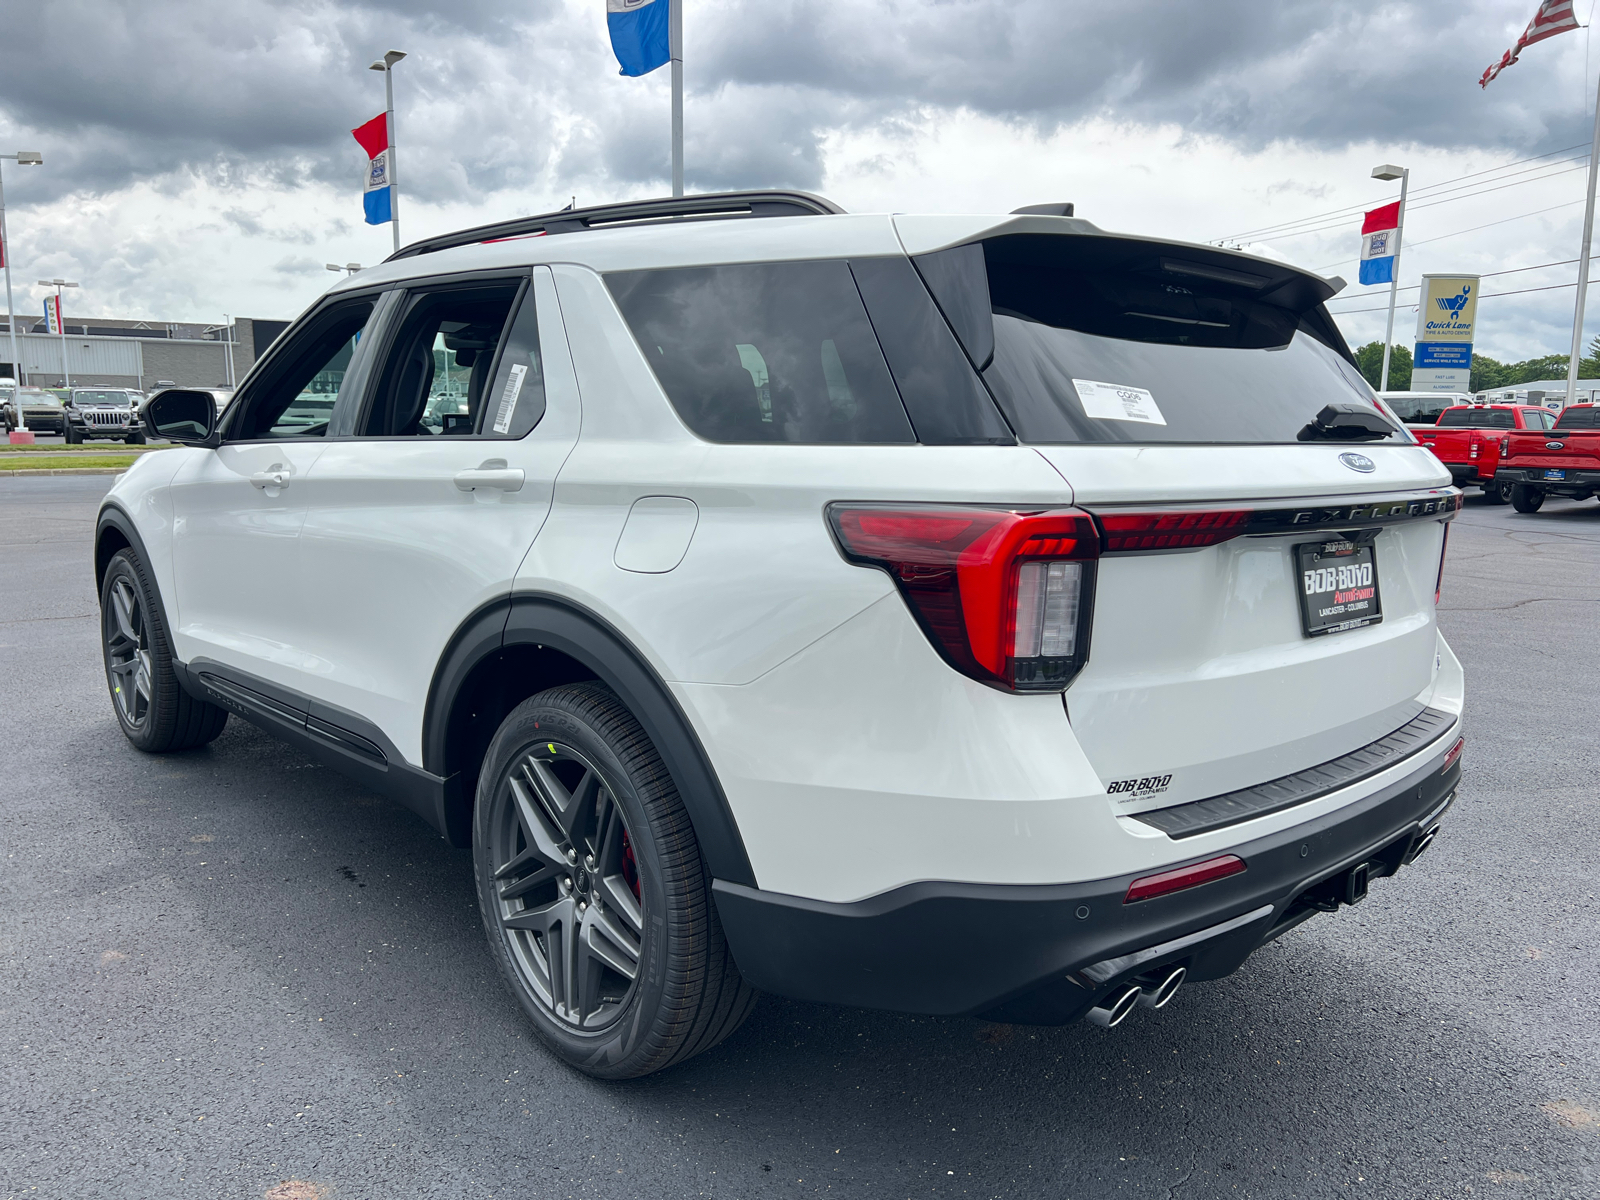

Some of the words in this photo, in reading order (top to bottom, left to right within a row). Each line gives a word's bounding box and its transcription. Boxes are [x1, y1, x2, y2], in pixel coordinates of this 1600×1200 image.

[1425, 321, 1451, 329] Quick
[1452, 321, 1471, 330] Lane
[1319, 605, 1345, 617] LANCASTER
[1347, 601, 1369, 612] COLUMBUS
